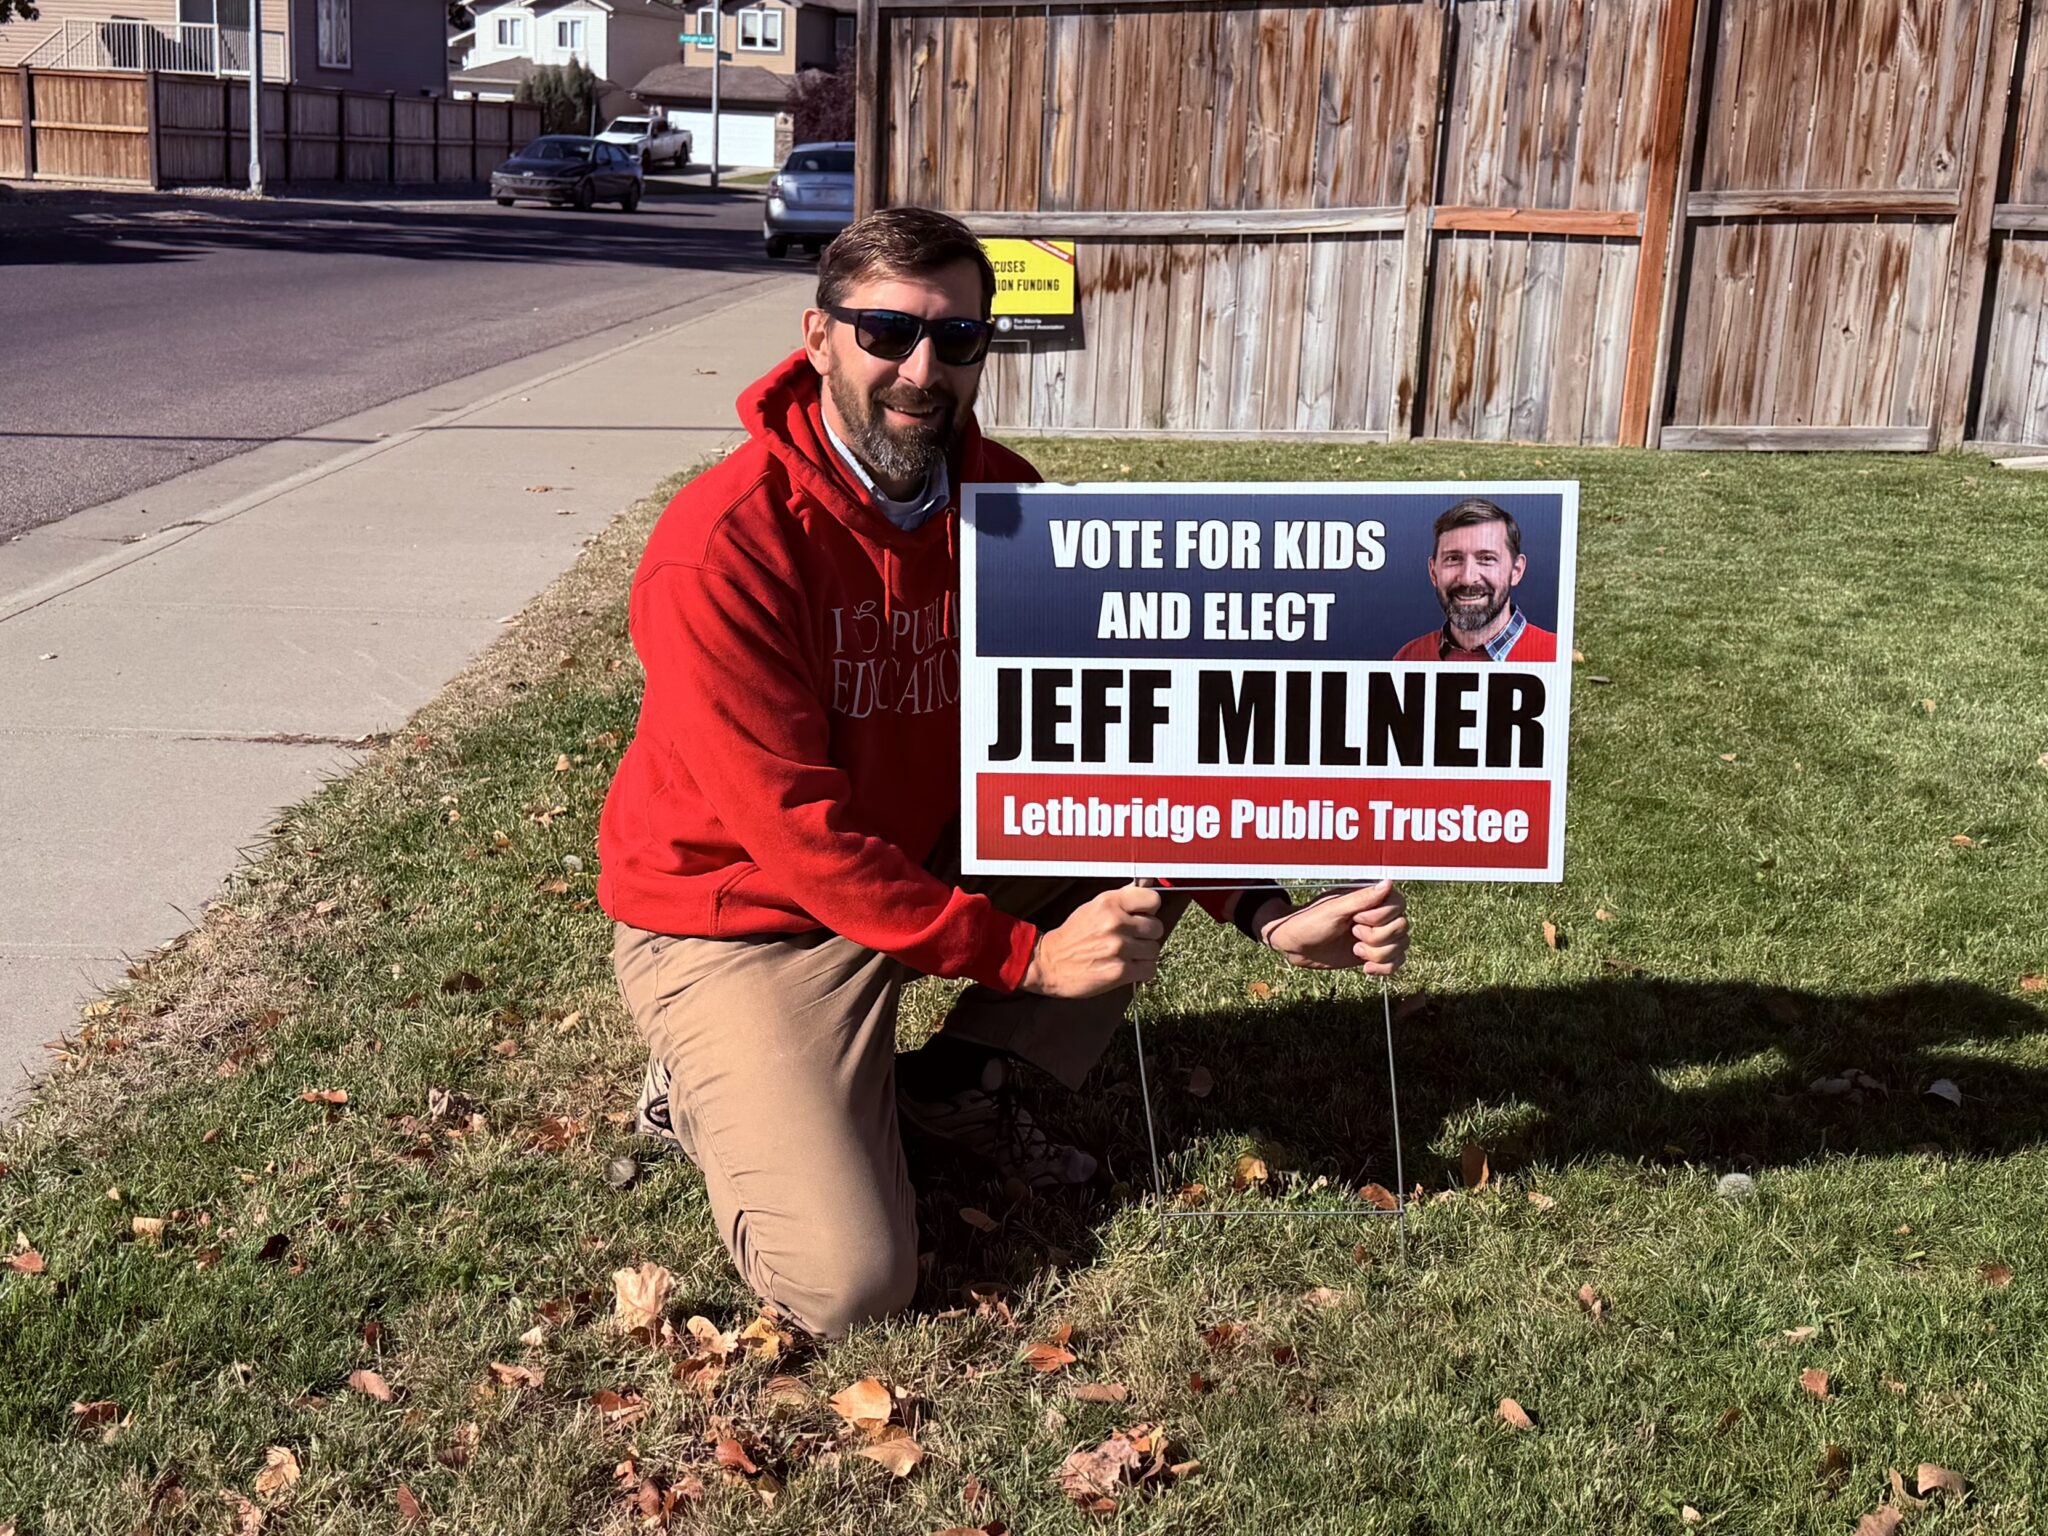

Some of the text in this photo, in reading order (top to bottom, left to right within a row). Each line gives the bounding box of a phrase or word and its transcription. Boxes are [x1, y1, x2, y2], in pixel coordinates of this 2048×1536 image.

[993, 260, 1026, 273] CUSES
[997, 279, 1060, 291] ION FUNDING
[1048, 519, 1386, 571] VOTE FOR KIDS
[831, 591, 961, 655] I PUBLI
[1097, 591, 1336, 642] AND ELECT
[831, 648, 961, 719] EDUCATIO
[988, 667, 1546, 769] JEFF MILNER
[1003, 795, 1530, 843] Lethbridge Public Trustee
